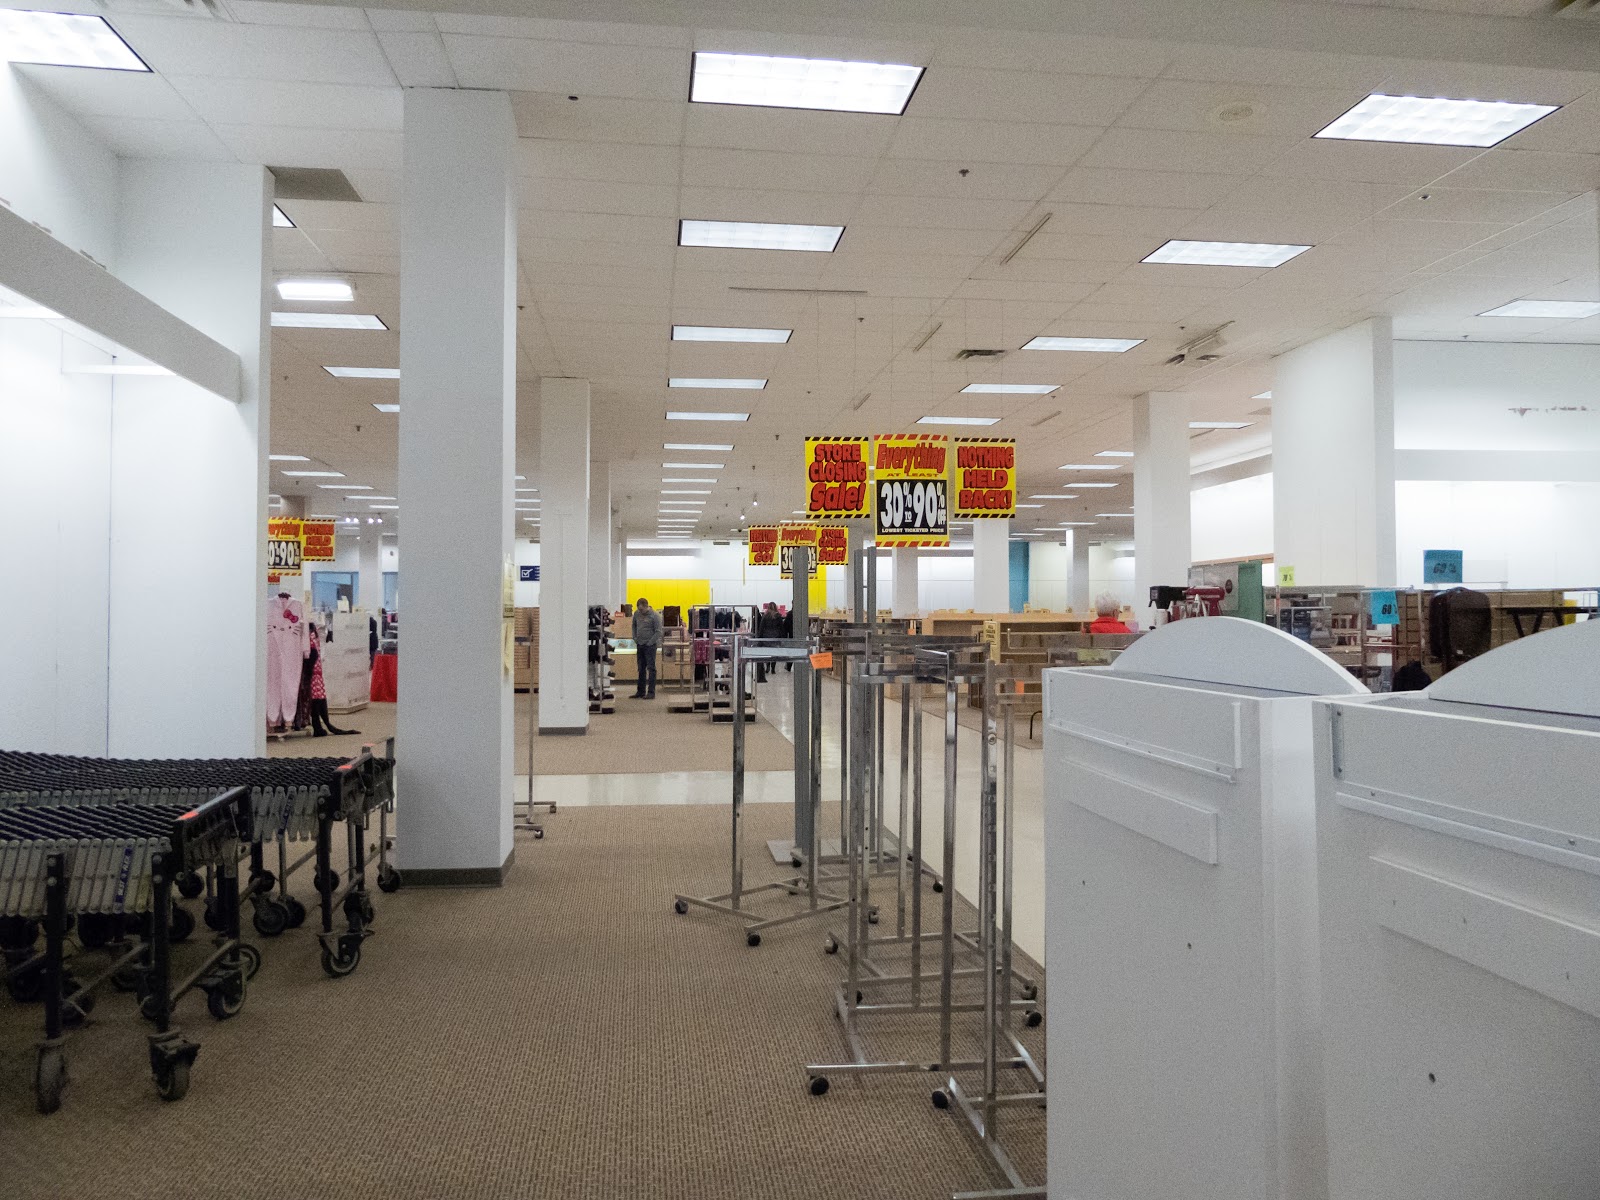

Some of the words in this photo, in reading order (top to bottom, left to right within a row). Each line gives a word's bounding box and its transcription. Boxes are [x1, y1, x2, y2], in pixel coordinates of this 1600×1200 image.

[814, 444, 861, 462] STORE
[876, 443, 946, 474] Everything
[957, 446, 1014, 469] NOTHING
[809, 461, 867, 482] CLOSING
[963, 470, 1009, 488] HELD
[809, 482, 866, 511] Sale!
[958, 489, 1013, 510] BACK!
[307, 536, 331, 546] HELD
[818, 537, 847, 548] CLOSING
[821, 529, 845, 538] STORE
[751, 543, 777, 553] MUST
[754, 551, 775, 563] GO!
[818, 547, 847, 562] Sale!
